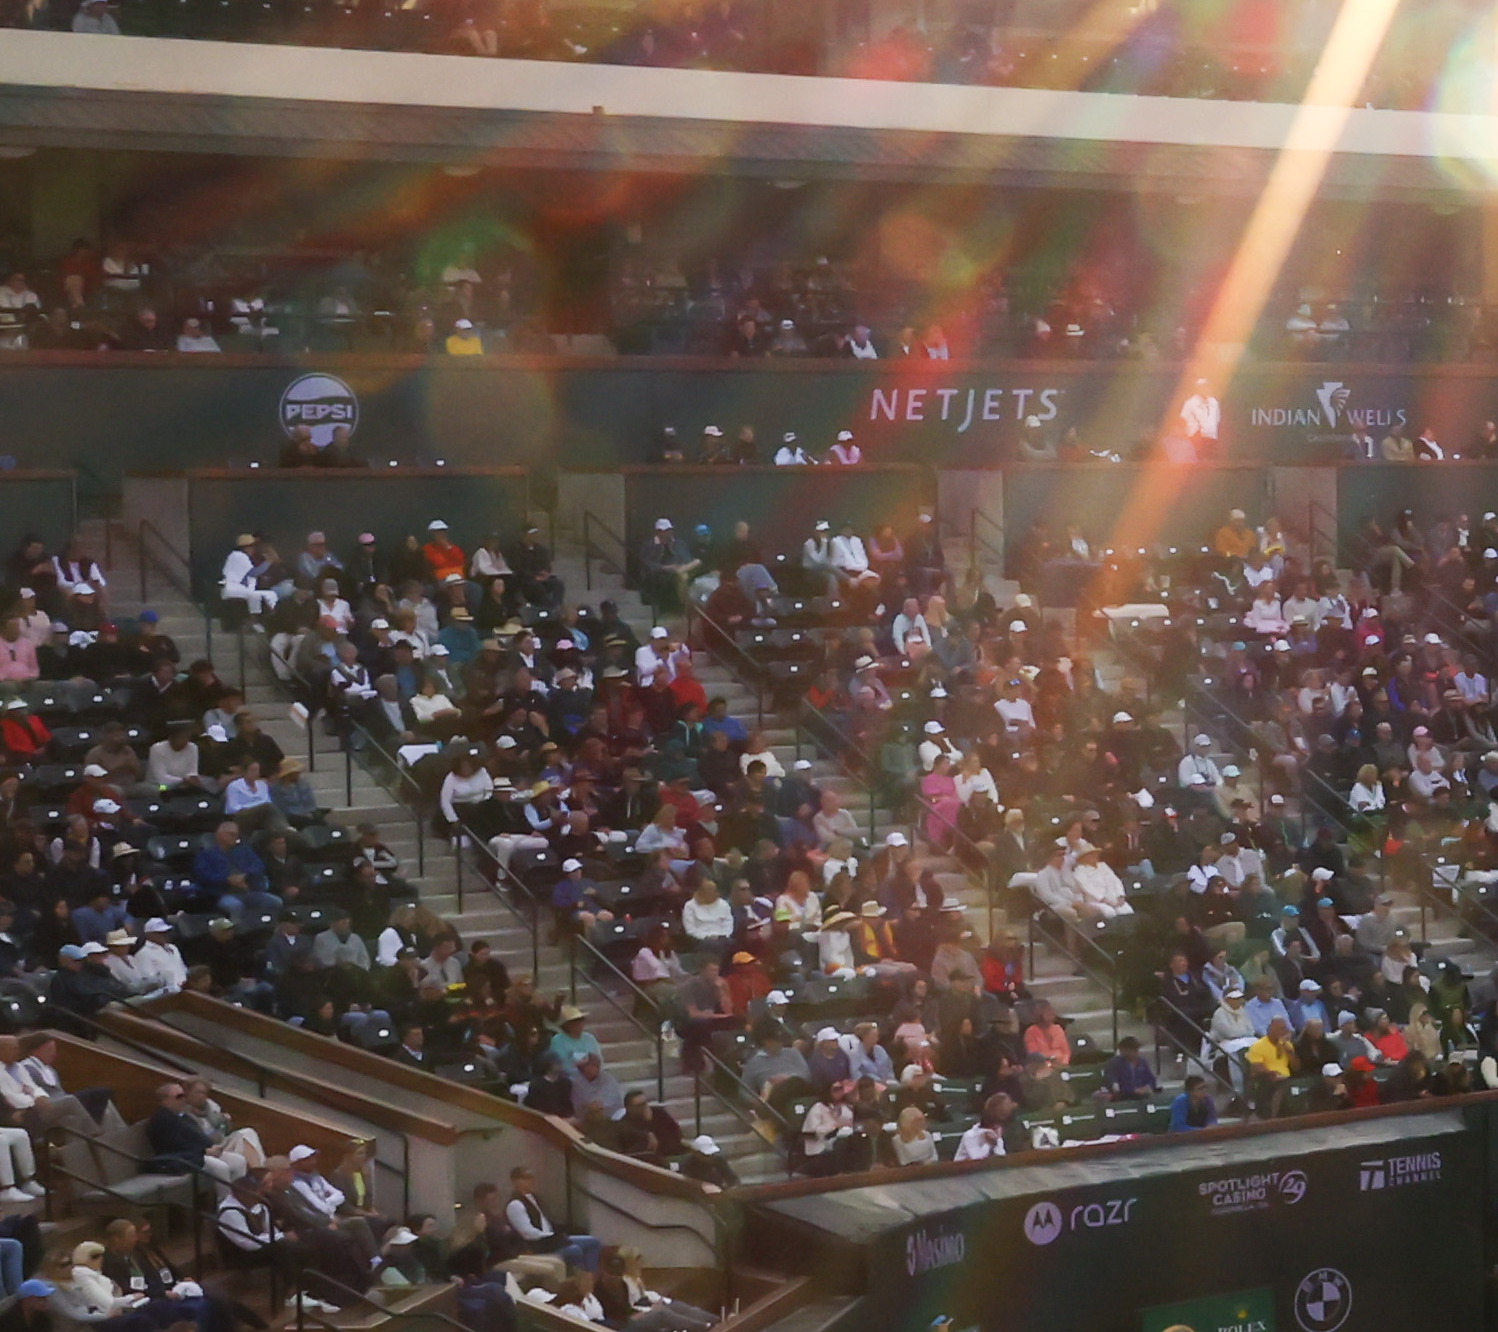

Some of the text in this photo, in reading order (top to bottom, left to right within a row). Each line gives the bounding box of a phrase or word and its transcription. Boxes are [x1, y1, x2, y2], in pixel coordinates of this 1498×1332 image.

[286, 404, 353, 419] PEPSI
[870, 388, 1058, 432] NETJETS
[1252, 409, 1320, 426] INDIAN
[1388, 1151, 1441, 1176] TENNIS
[1198, 1172, 1280, 1195] SPOTLIGHT
[1070, 1197, 1138, 1231] razr
